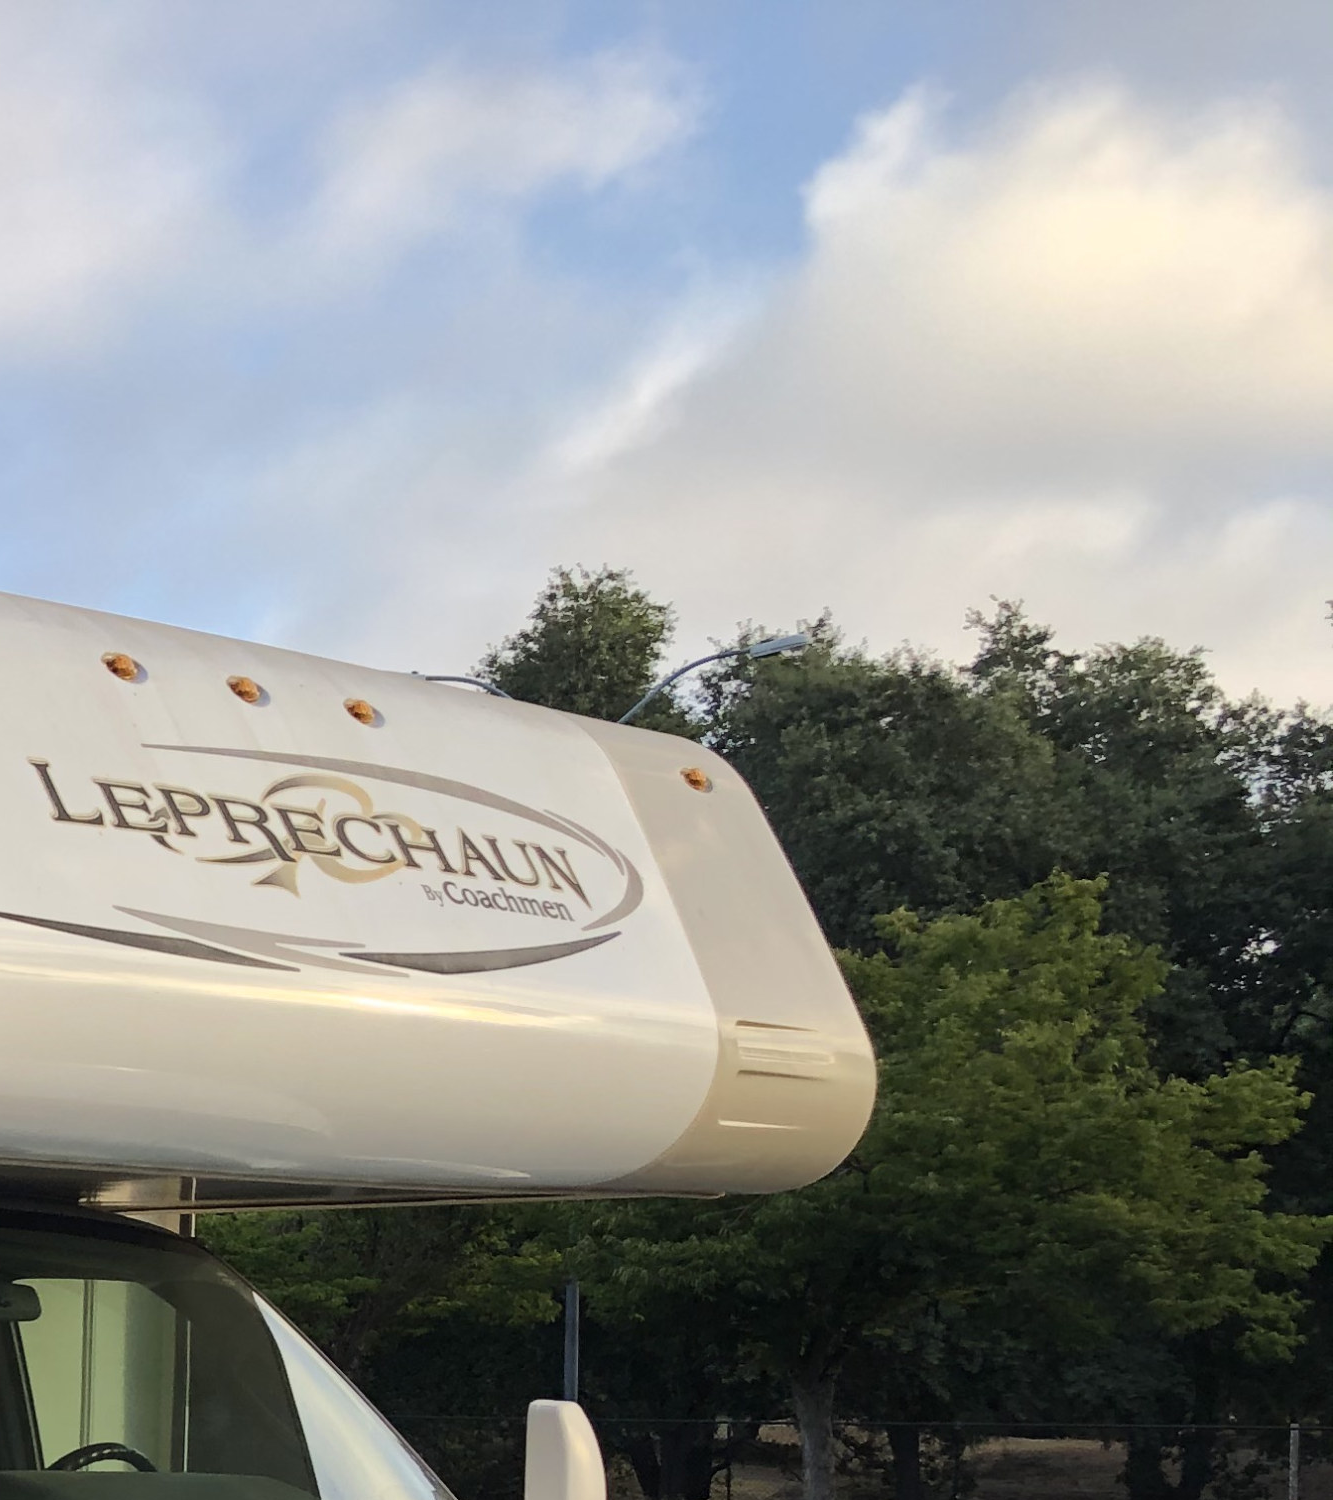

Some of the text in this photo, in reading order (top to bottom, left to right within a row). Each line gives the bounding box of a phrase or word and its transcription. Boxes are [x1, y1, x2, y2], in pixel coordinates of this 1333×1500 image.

[27, 757, 593, 911] LEPRECHAUN
[420, 881, 576, 922] By Coachmen
